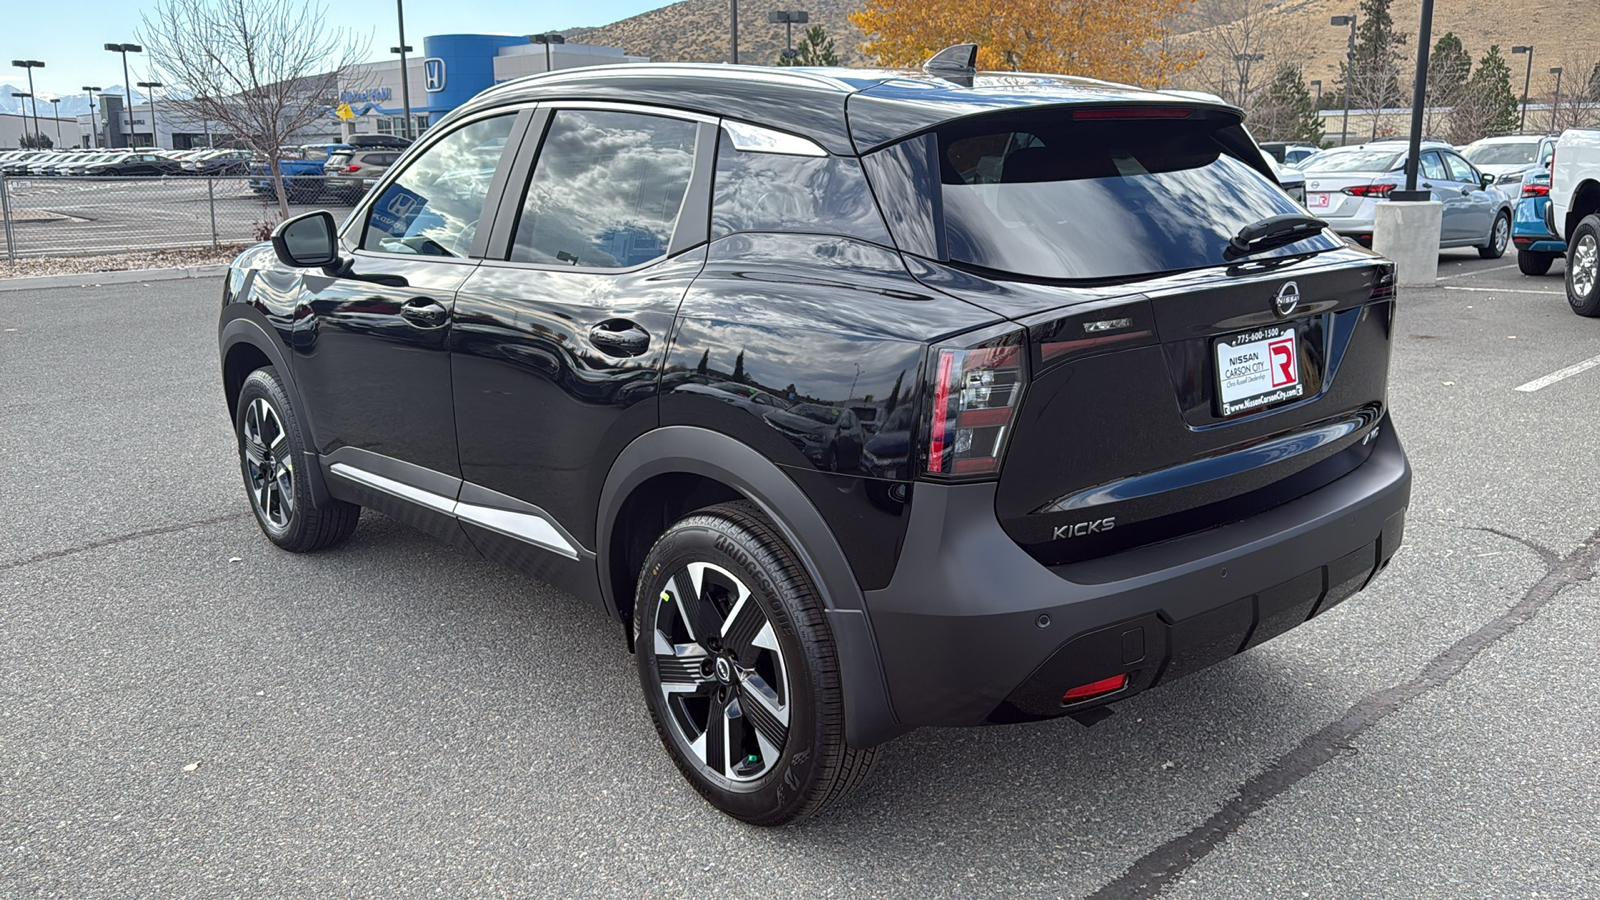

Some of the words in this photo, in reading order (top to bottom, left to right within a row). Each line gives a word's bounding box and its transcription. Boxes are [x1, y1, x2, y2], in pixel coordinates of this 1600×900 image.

[1276, 295, 1300, 304] NISSAN
[1237, 328, 1279, 344] 775-600-1500
[1229, 352, 1259, 366] NISSAN
[1225, 364, 1251, 378] CARSON
[1252, 361, 1265, 373] CITY
[1226, 379, 1236, 388] Chris
[1230, 388, 1296, 412] www.NissanCarsonCity.com
[1053, 516, 1116, 540] KICKS
[713, 534, 796, 637] BRIDGESTONE
